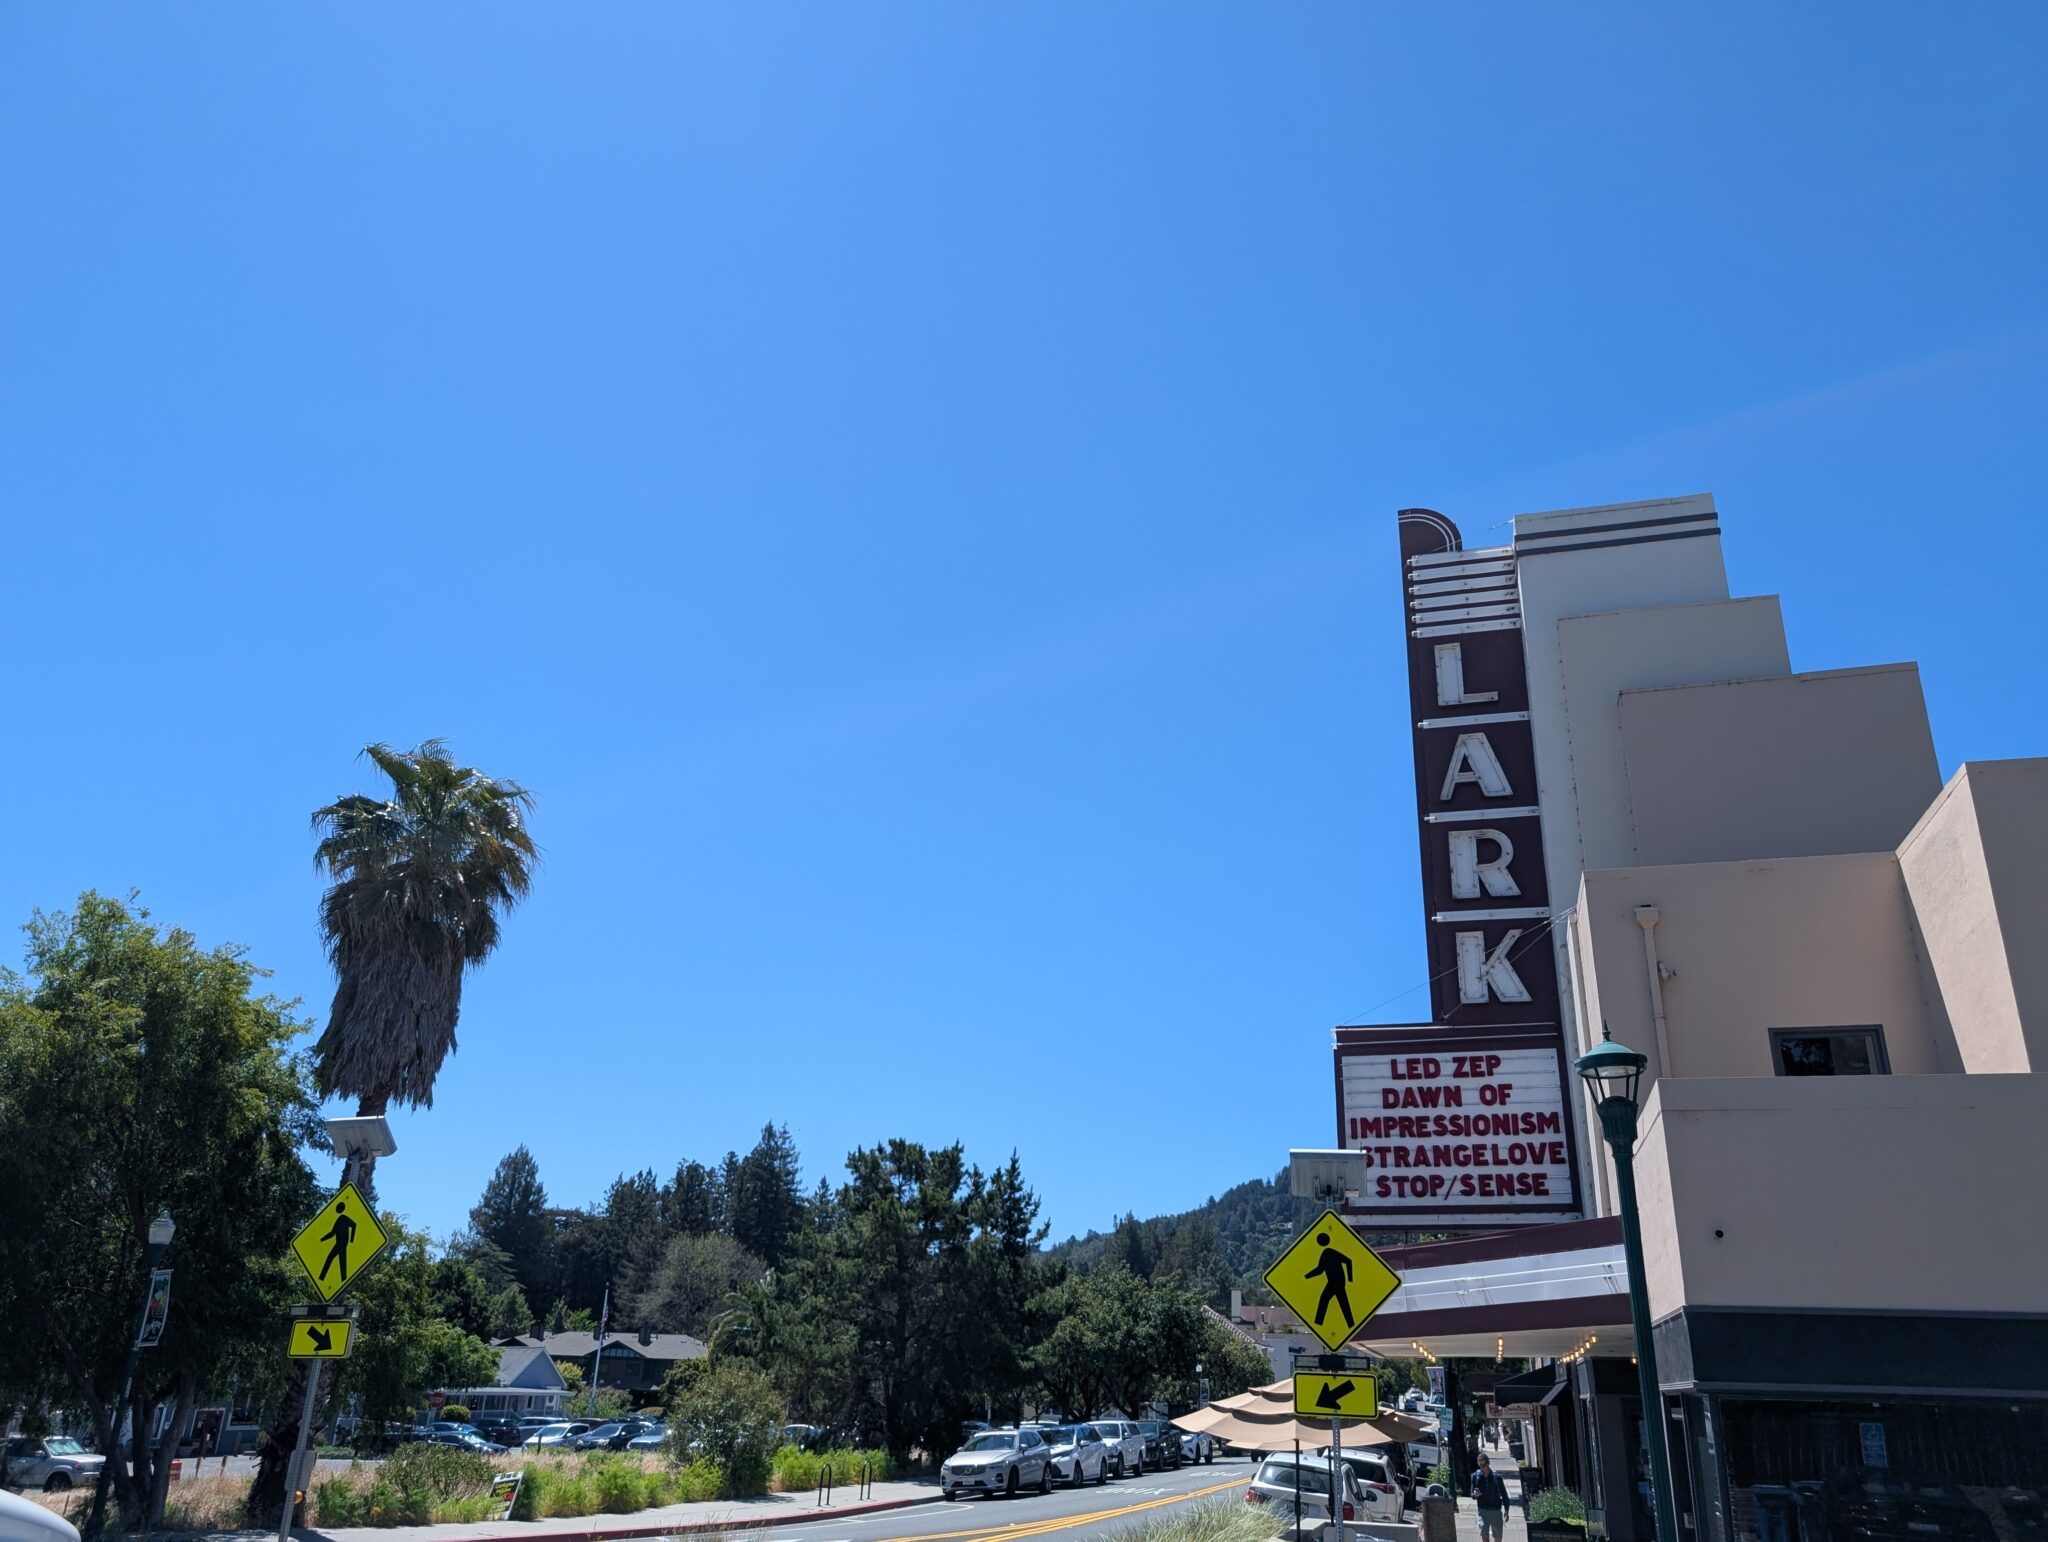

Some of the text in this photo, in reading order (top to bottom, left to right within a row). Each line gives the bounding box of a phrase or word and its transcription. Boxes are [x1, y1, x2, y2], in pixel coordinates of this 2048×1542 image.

[1434, 642, 1533, 1004] LARK
[1390, 1055, 1501, 1080] LED ZEP
[1381, 1083, 1513, 1109] DAWN OF
[1350, 1111, 1561, 1140] IMPRESSIONISM
[1376, 1173, 1549, 1200] STOP/SENSE
